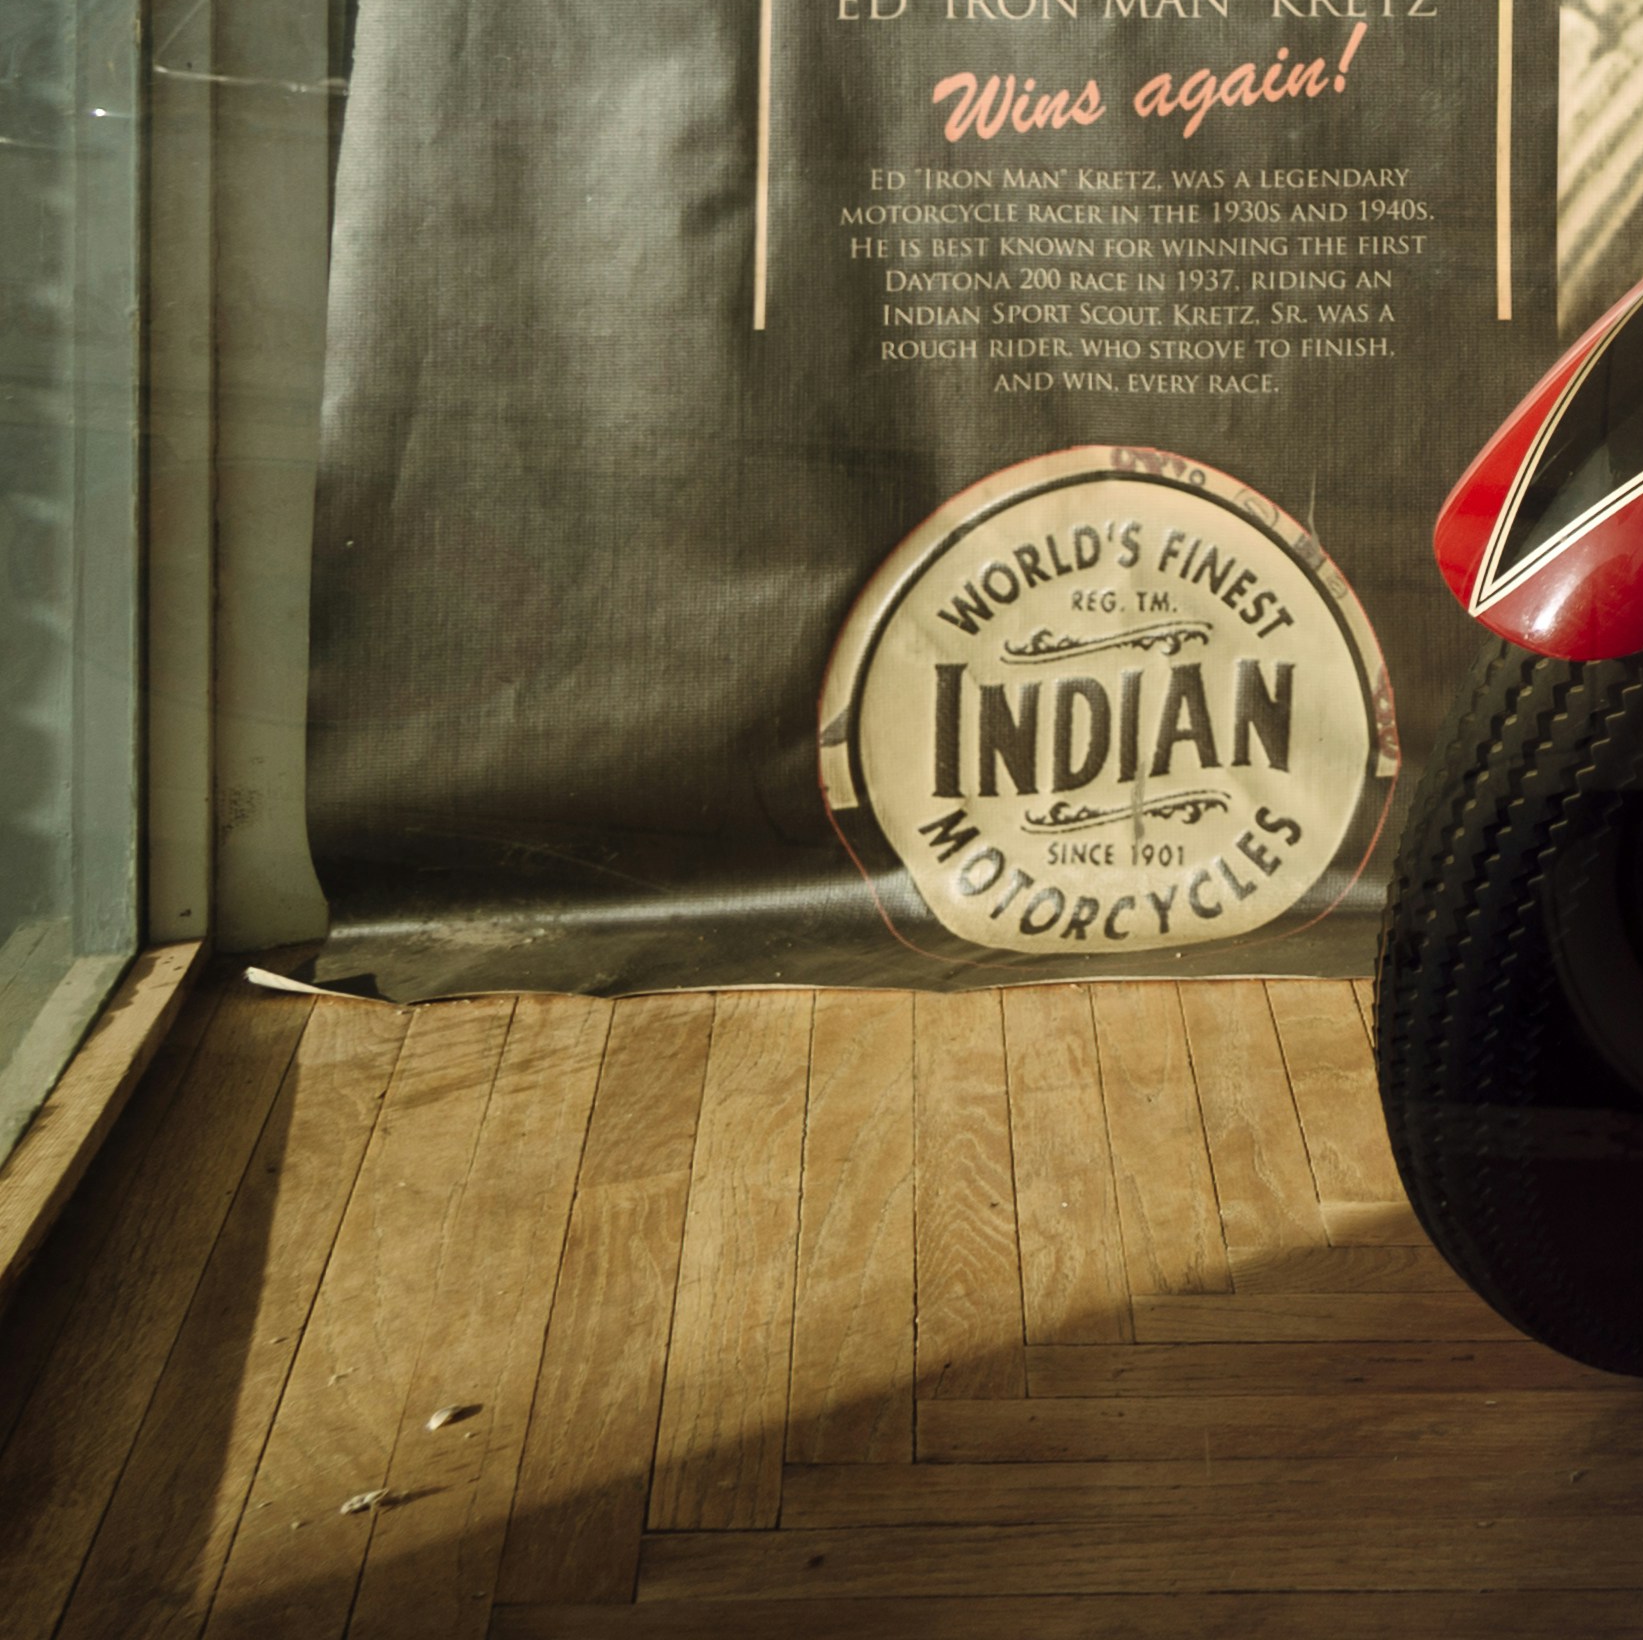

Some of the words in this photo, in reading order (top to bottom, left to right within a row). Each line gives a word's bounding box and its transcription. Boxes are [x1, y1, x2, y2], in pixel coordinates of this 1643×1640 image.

[932, 71, 1107, 144] Wins
[1133, 21, 1369, 139] again!
[870, 168, 906, 191] ED
[1171, 169, 1225, 189] WAS
[1234, 169, 1251, 189] A
[1260, 167, 1410, 189] LEGENDARY
[840, 204, 1018, 226] MOTORCYCLE
[1027, 203, 1103, 225] RACER
[1112, 204, 1139, 225] IN
[1150, 204, 1199, 224] THE
[1290, 201, 1348, 223] AND
[850, 237, 889, 259] HE
[900, 238, 921, 258] IS
[932, 237, 990, 258] BEST
[999, 236, 1095, 258] KNOWN
[1104, 237, 1154, 259] FOR
[1161, 236, 1289, 258] WINNING
[1298, 236, 1348, 257] THE
[1358, 234, 1428, 256] FIRST
[885, 270, 1011, 293] DAYTONA
[1019, 268, 1062, 290] 200
[1069, 270, 1128, 292] RACE
[1137, 271, 1166, 292] IN
[1176, 268, 1241, 293] 1937,
[1251, 270, 1347, 291] RIDING
[1354, 269, 1393, 290] AN
[882, 304, 981, 327] INDIAN
[991, 302, 1072, 325] SPORT
[1079, 302, 1163, 326] SCOUT.
[1317, 303, 1369, 324] WAS
[1378, 303, 1396, 323] A
[880, 339, 978, 361] ROUGH
[1081, 338, 1142, 360] WHO
[1149, 338, 1246, 360] STROVE
[1255, 338, 1291, 358] TO
[1301, 337, 1395, 359] FINISH,
[993, 371, 1054, 393] AND
[1128, 373, 1200, 394] EVERY
[1208, 373, 1280, 394] RACE.
[936, 519, 1142, 638] WORLD'S
[1158, 527, 1297, 640] FINEST
[1070, 589, 1126, 614] REG.
[931, 658, 1296, 799] INDIAN
[1046, 842, 1115, 867] SINCE
[1131, 842, 1186, 868] 1901
[918, 805, 1303, 942] MOTORCYCLES
